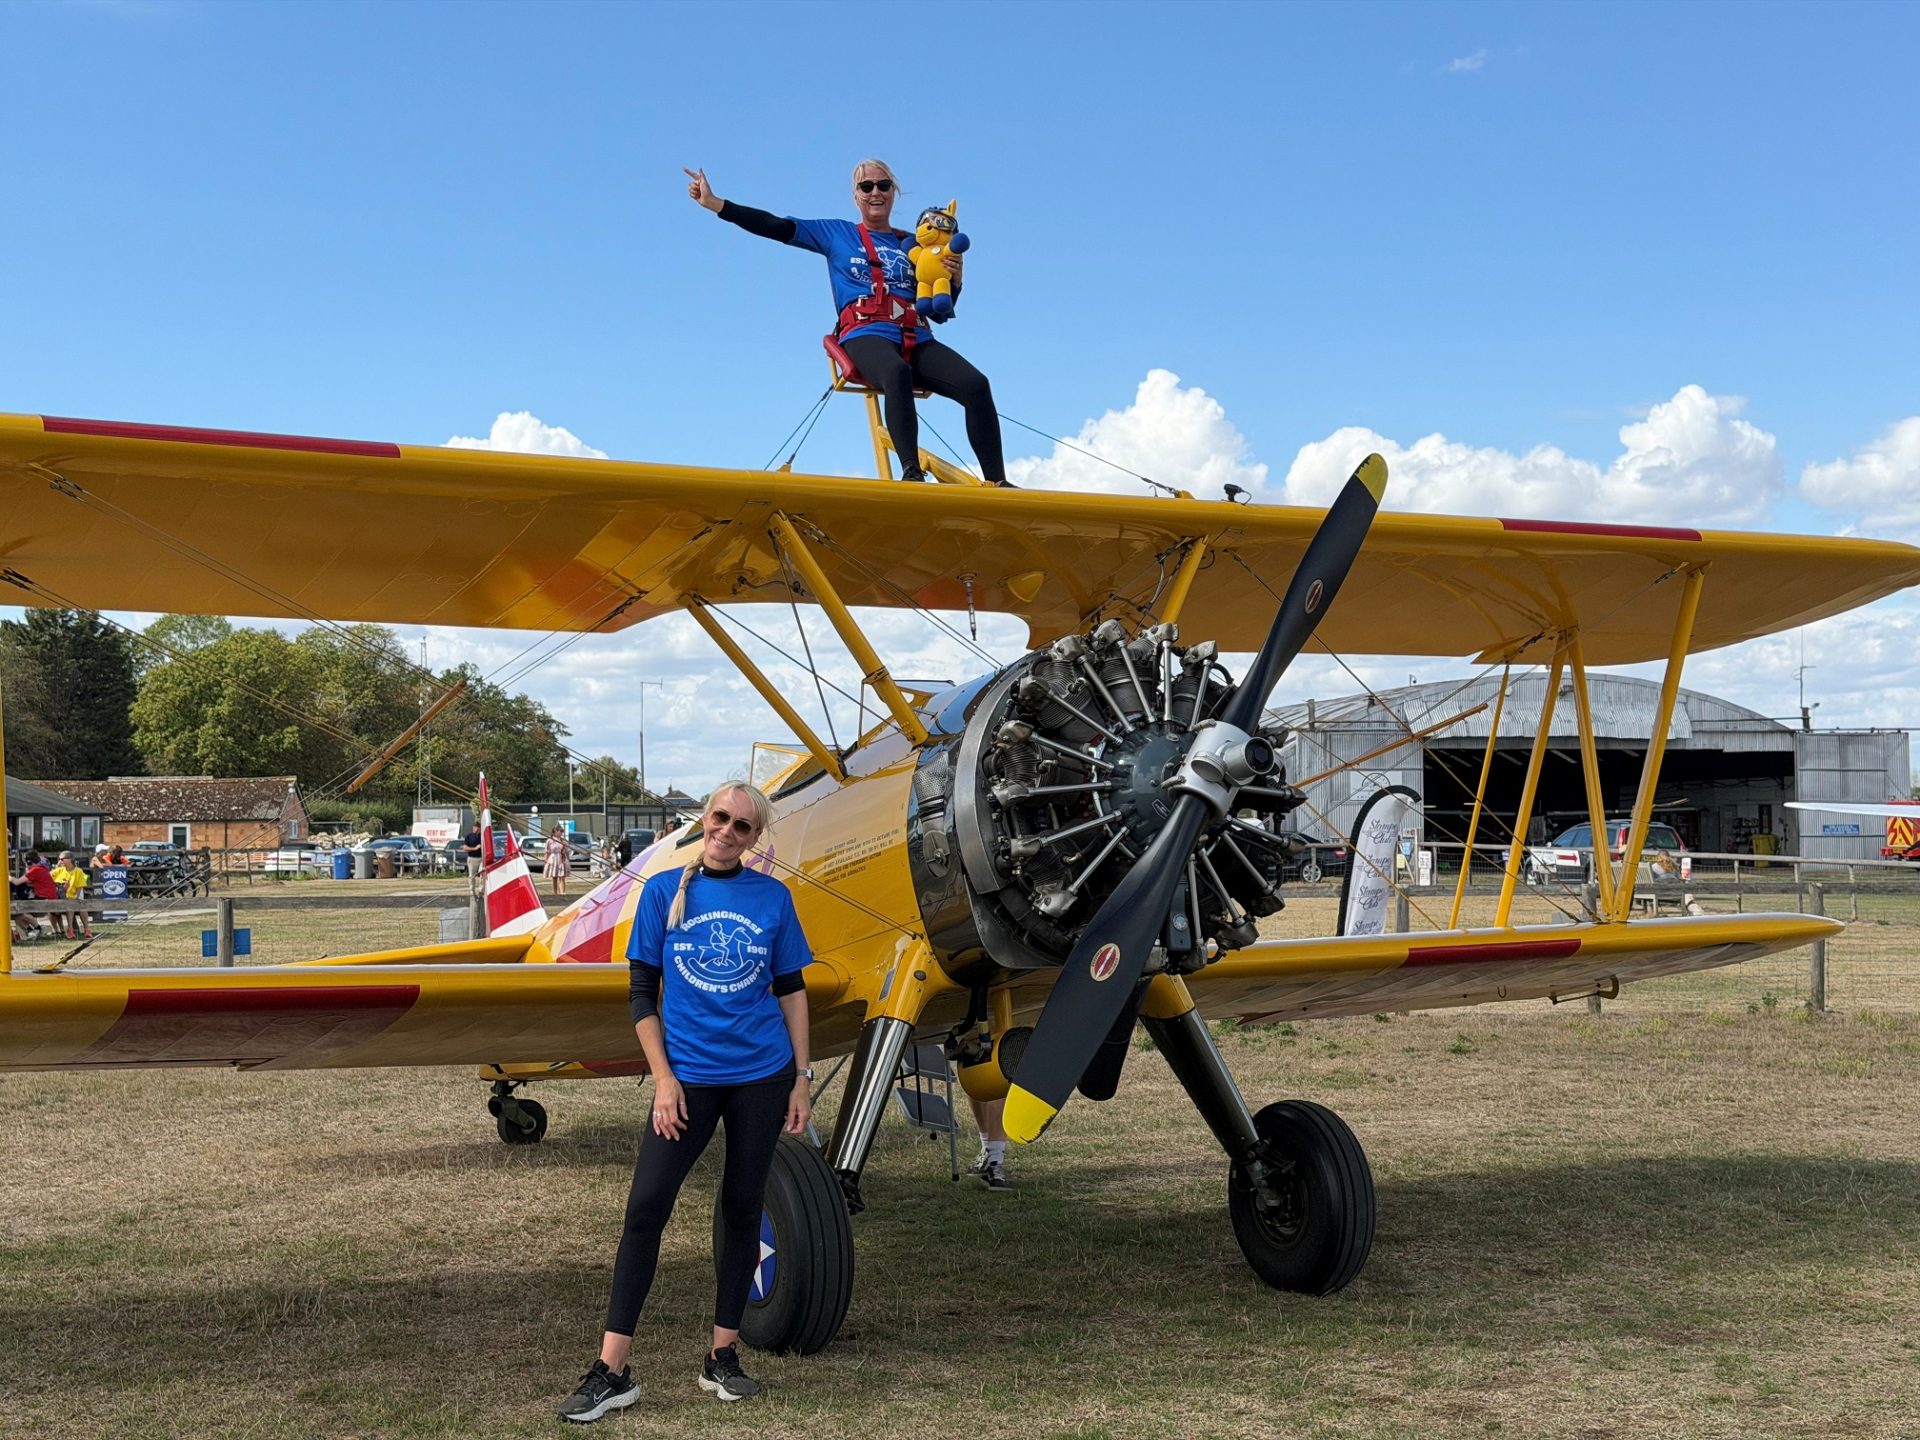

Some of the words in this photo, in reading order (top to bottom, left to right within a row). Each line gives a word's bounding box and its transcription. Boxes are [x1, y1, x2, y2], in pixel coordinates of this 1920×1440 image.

[850, 257, 868, 265] EST.
[103, 871, 127, 879] OPEN
[1359, 886, 1384, 899] Stampe
[1359, 896, 1379, 910] Club
[682, 910, 763, 935] ROCKINGHORSE
[673, 942, 695, 951] EST.
[674, 955, 728, 993] CHILDREN'S
[729, 960, 766, 992] CHARITY
